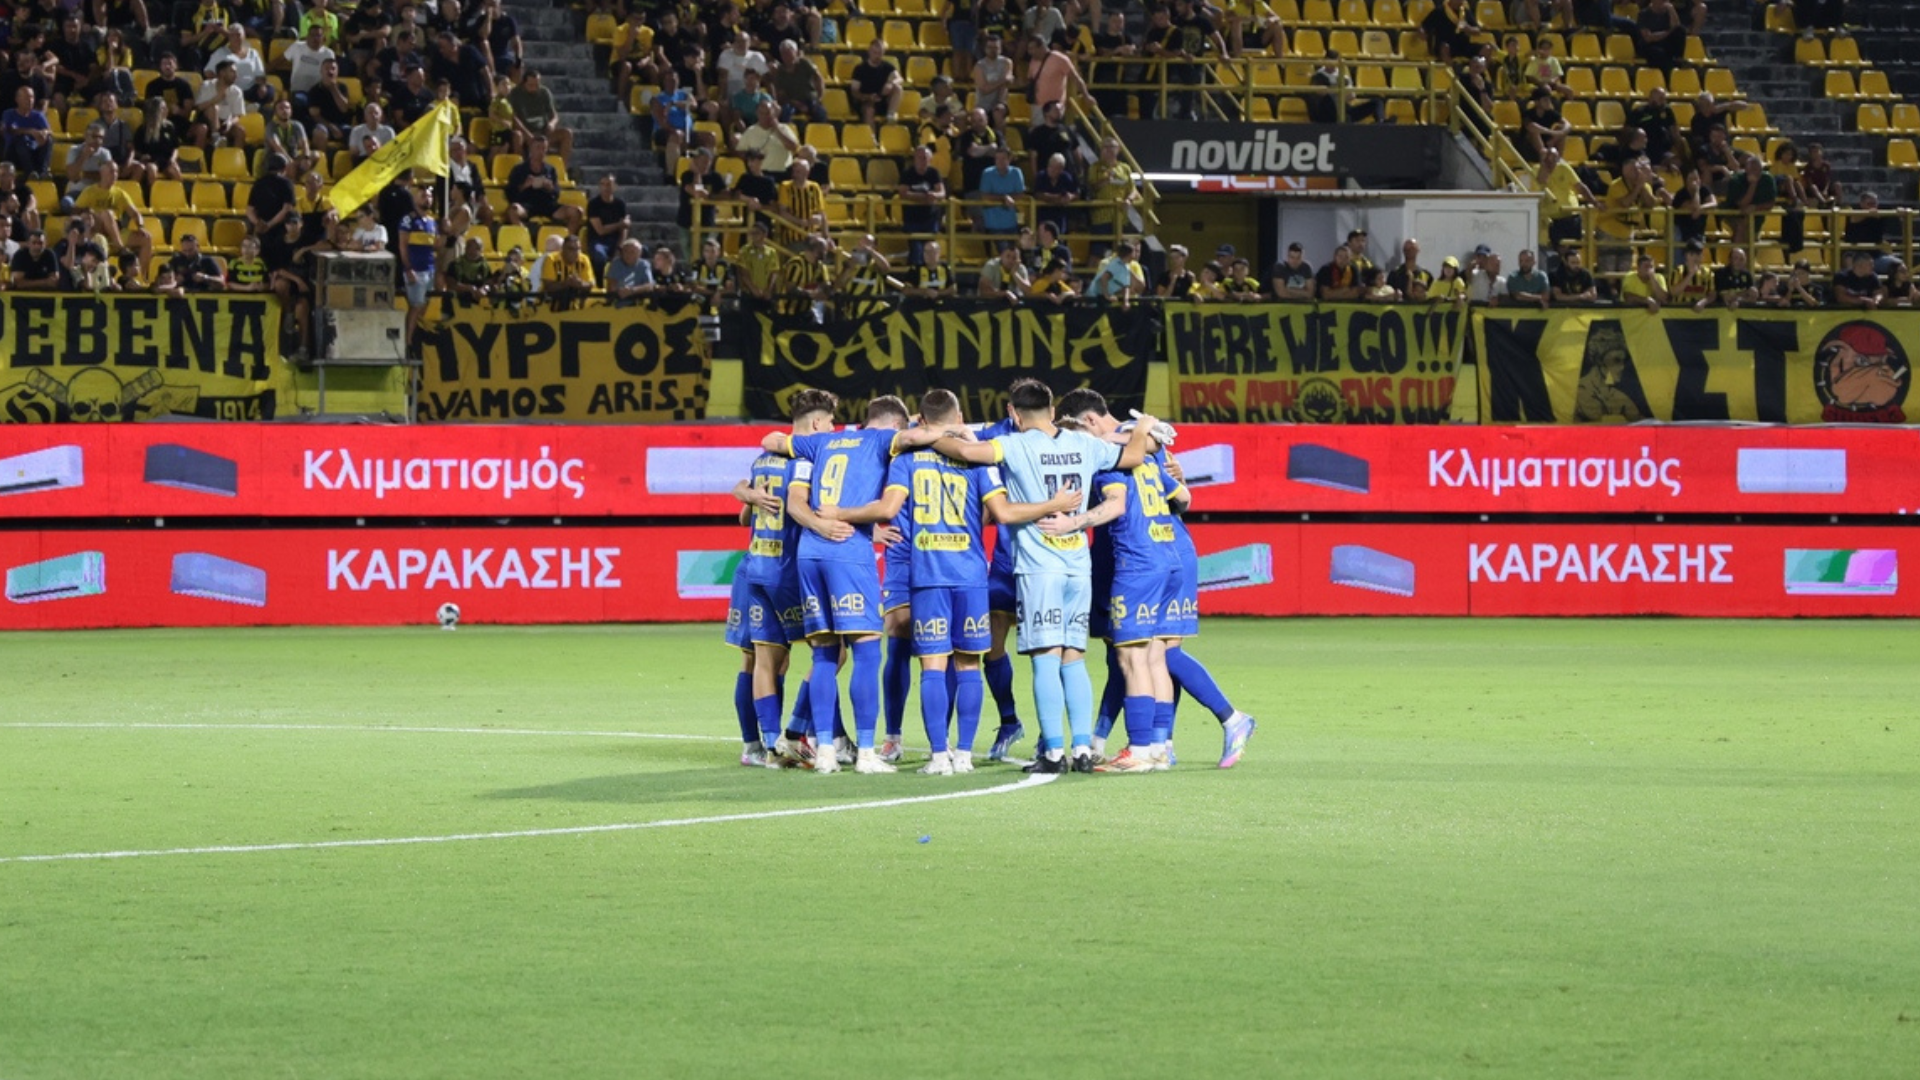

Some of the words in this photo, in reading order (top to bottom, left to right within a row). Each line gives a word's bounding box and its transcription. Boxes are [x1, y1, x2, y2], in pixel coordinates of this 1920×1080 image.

[1171, 129, 1335, 172] novibet
[0, 297, 270, 380] ΕΒΕΝΑ
[1172, 311, 1278, 375] HERE
[1280, 309, 1340, 375] WE
[214, 400, 262, 422] 1914
[429, 384, 566, 421] VAMOS
[1179, 379, 1239, 423] ARIS
[303, 446, 584, 497] Κλιματισμός
[820, 453, 849, 505] 9
[1429, 447, 1681, 495] Κλιματισμός
[328, 547, 621, 589] ΚΑΡΑΚΑΣΗΣ
[1469, 544, 1732, 584] ΚΑΡΑΚΑΣΗΣ
[913, 616, 948, 635] A4B
[1033, 608, 1062, 627] A4B
